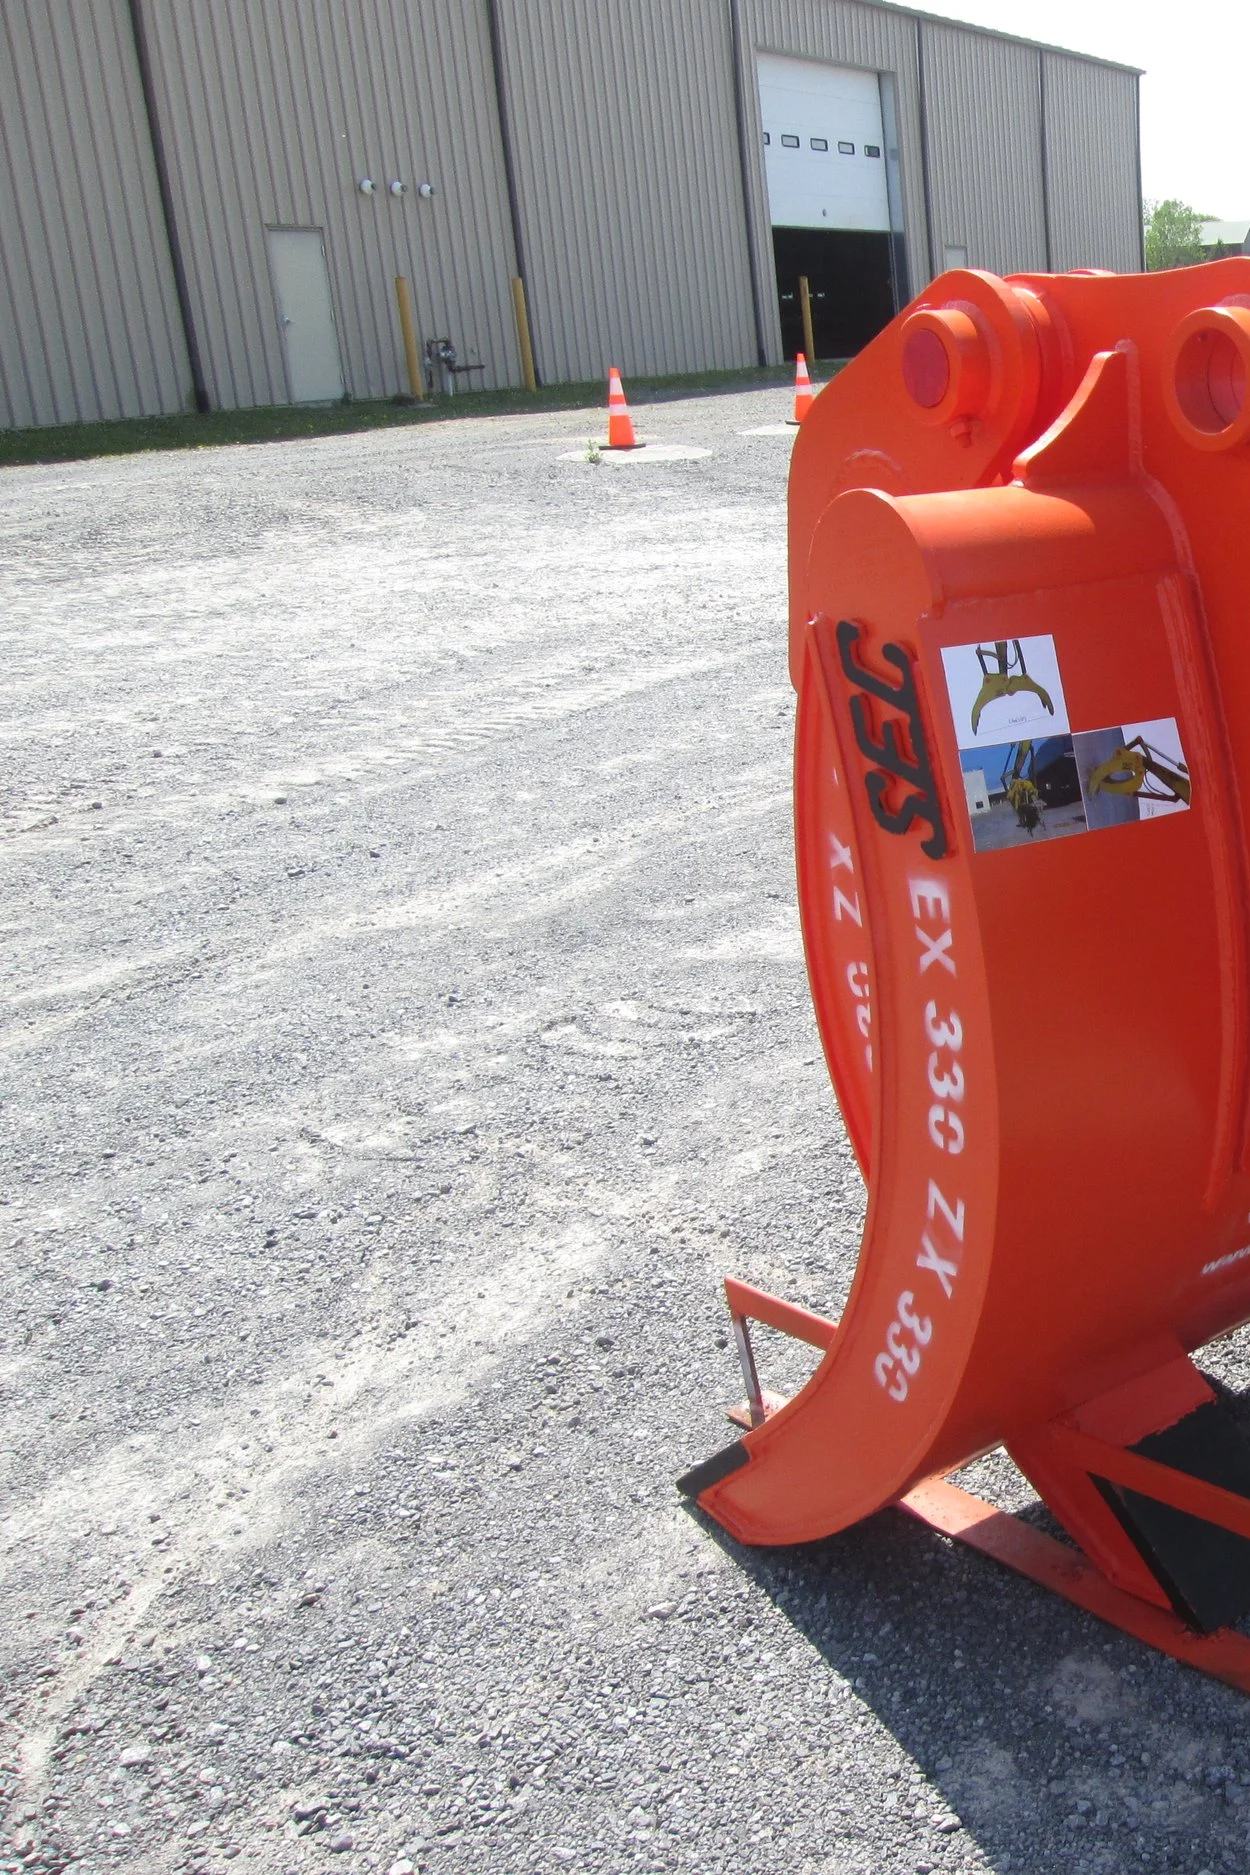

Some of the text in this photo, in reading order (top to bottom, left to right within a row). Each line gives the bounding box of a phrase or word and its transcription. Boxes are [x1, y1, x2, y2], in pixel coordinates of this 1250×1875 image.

[836, 620, 949, 861] SEC
[872, 877, 966, 1403] EX 330 ZX 330
